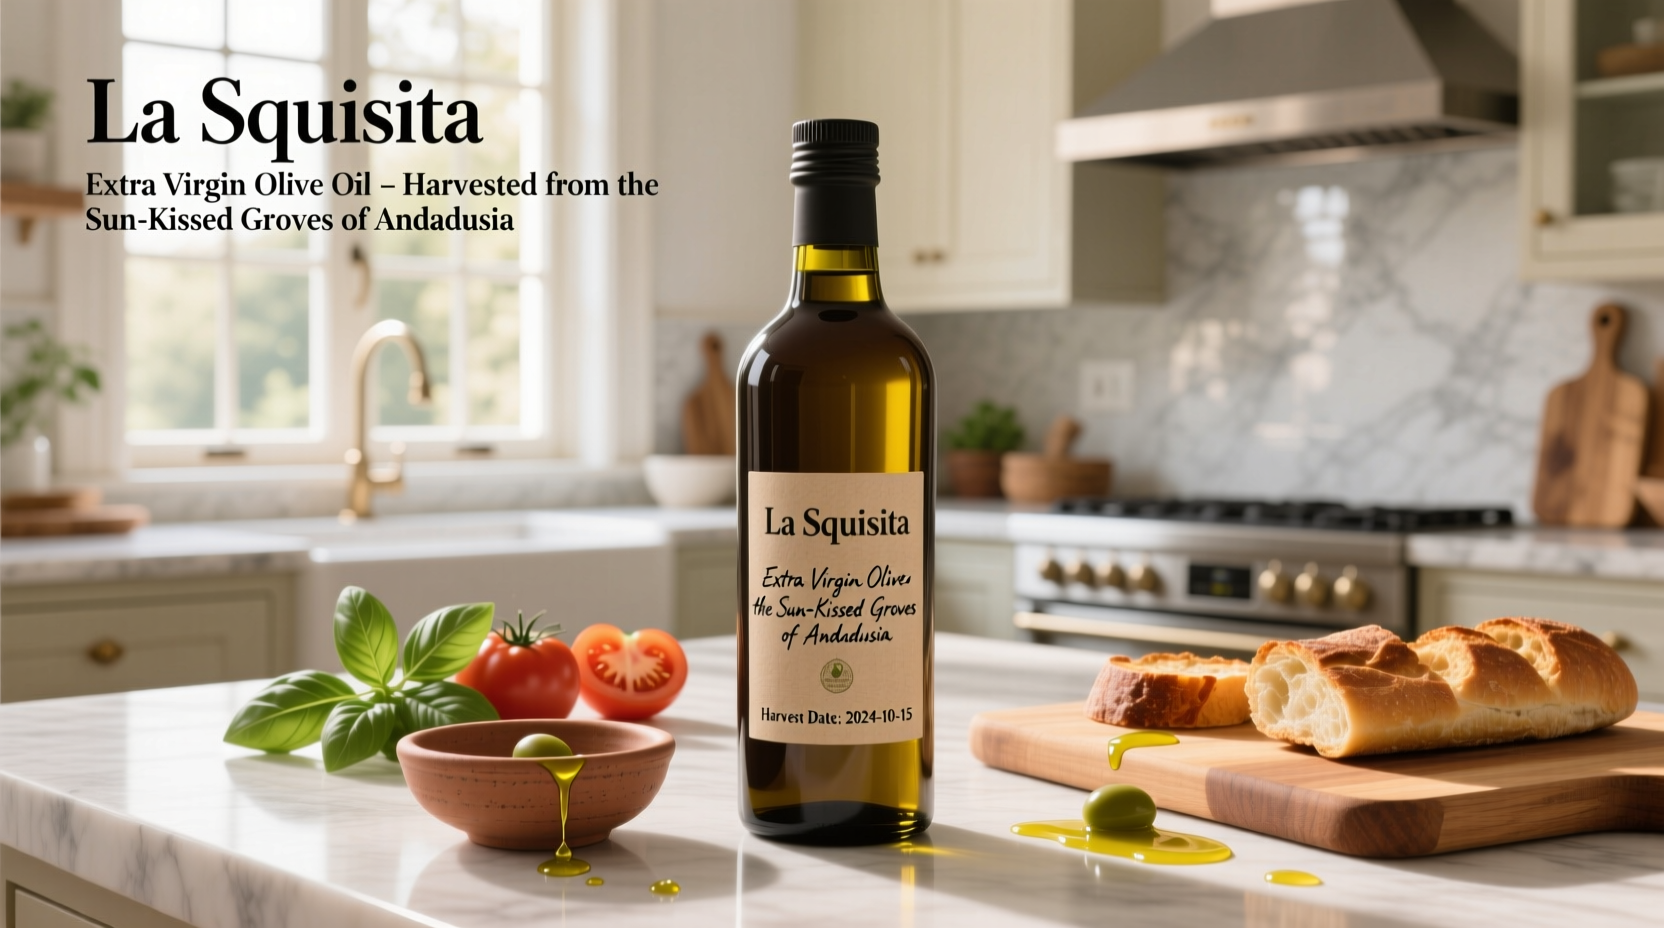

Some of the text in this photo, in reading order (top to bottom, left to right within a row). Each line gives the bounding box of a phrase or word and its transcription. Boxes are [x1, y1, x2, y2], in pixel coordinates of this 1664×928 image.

[765, 507, 910, 545] La Squisita
[762, 566, 804, 588] Extra
[812, 567, 863, 598] Virgin
[752, 596, 917, 622] the Sun-Kissed Groves
[781, 623, 800, 651] of
[761, 707, 913, 725] Harvest Date: 2024-10-15
